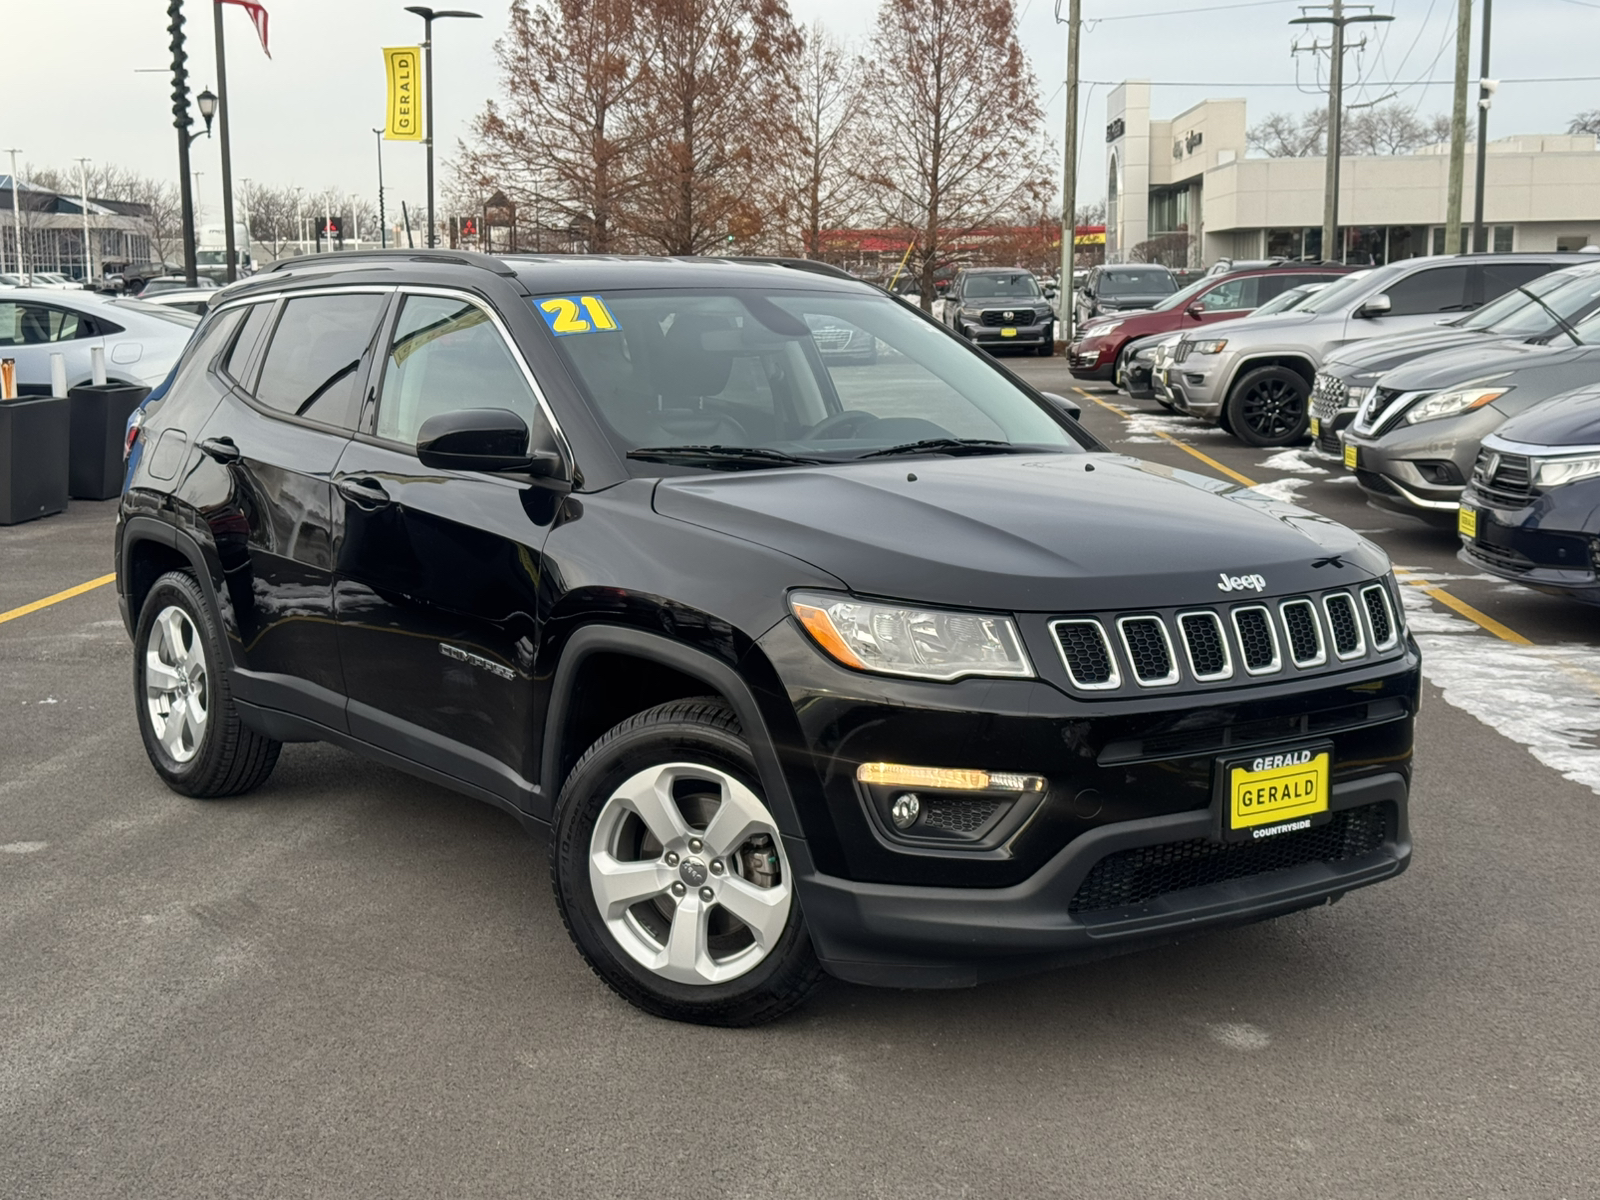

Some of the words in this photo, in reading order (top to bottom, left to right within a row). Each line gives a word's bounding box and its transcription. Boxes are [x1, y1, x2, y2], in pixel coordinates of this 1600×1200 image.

[398, 59, 410, 128] GERALD
[540, 296, 617, 332] 21
[1217, 573, 1266, 593] Jeep
[1253, 750, 1311, 772] GERALD
[1241, 779, 1315, 807] GERALD
[1253, 819, 1311, 839] COUNTRYSIDE
